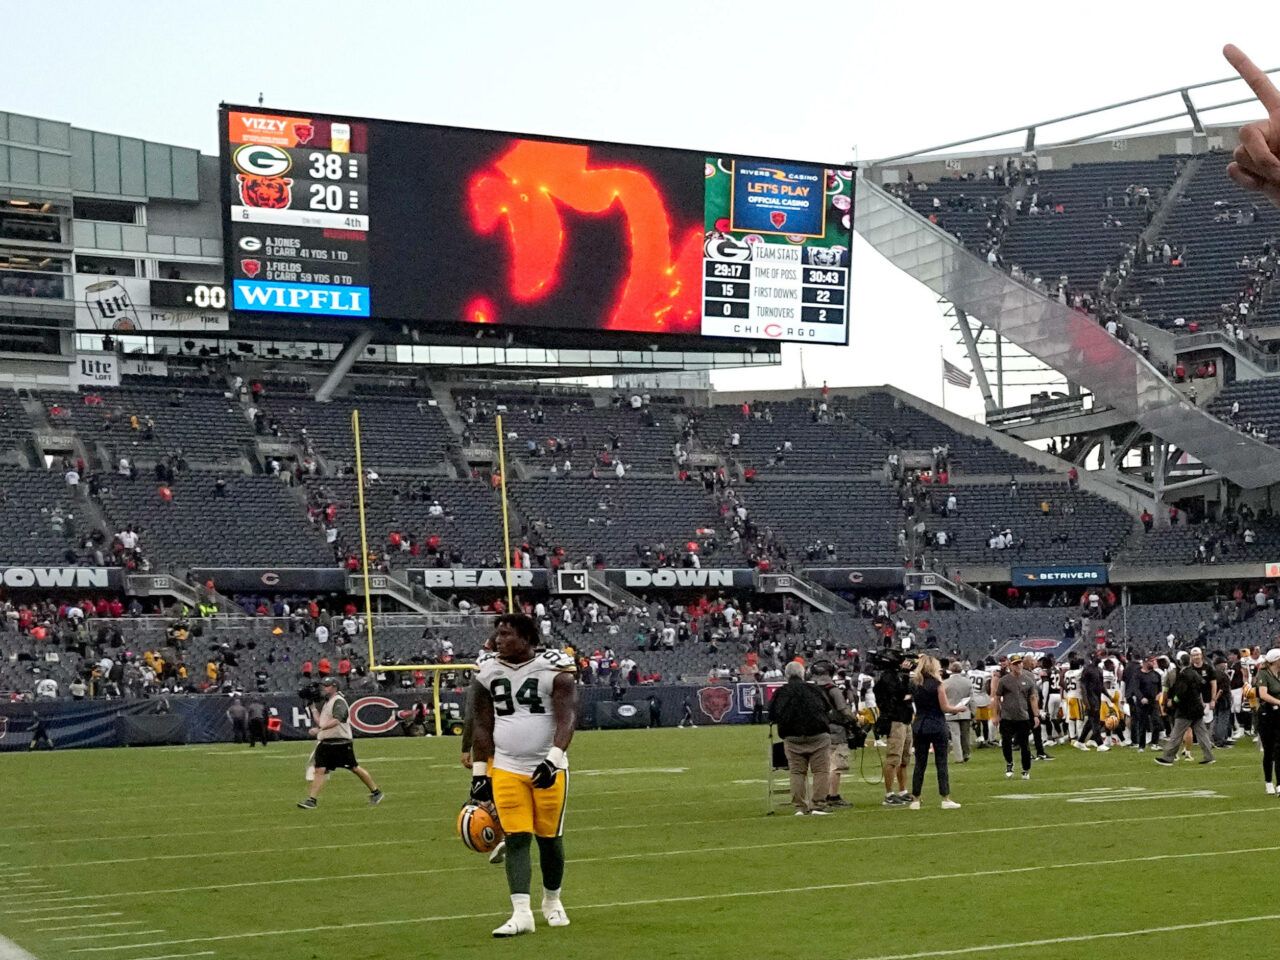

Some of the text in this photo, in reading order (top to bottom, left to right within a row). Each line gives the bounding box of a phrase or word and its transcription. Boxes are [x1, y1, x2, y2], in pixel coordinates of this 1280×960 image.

[241, 117, 288, 130] VIZZY
[309, 152, 342, 180] 38
[740, 168, 818, 182] RIVERS CASINO
[748, 182, 810, 197] LET'S PLAY
[309, 184, 342, 211] 20
[748, 196, 781, 205] OFFICIAL
[782, 198, 809, 207] CASINO
[344, 217, 361, 228] 4th
[265, 237, 301, 248] A.JONES
[266, 247, 272, 255] 9
[273, 247, 296, 257] CARR
[300, 249, 310, 258] 41
[311, 249, 328, 259] YDS
[338, 251, 348, 260] TD
[756, 247, 777, 259] TEAM
[777, 248, 799, 261] STATS
[266, 261, 302, 272] J.FIELDS
[714, 265, 742, 277] 29:17
[754, 267, 770, 277] TIME
[771, 269, 780, 278] OF
[809, 271, 839, 283] 30:43
[266, 271, 272, 280] 9
[274, 271, 297, 281] CARR
[300, 273, 312, 282] 59
[313, 273, 330, 284] YDS
[342, 276, 352, 285] TD
[238, 285, 362, 311] WIPFLI
[722, 284, 830, 302] 15 FIRST DOWNS 22
[96, 294, 131, 318] Lite
[723, 303, 827, 321] 0 TURNOVERS 2
[200, 315, 220, 324] TIME
[81, 359, 112, 376] Lite
[0, 569, 109, 587] OWN
[424, 570, 534, 587] BEAR
[574, 575, 585, 588] 4
[625, 570, 733, 586] DOWN
[1040, 572, 1098, 580] BETRIVERS
[490, 677, 546, 717] 94
